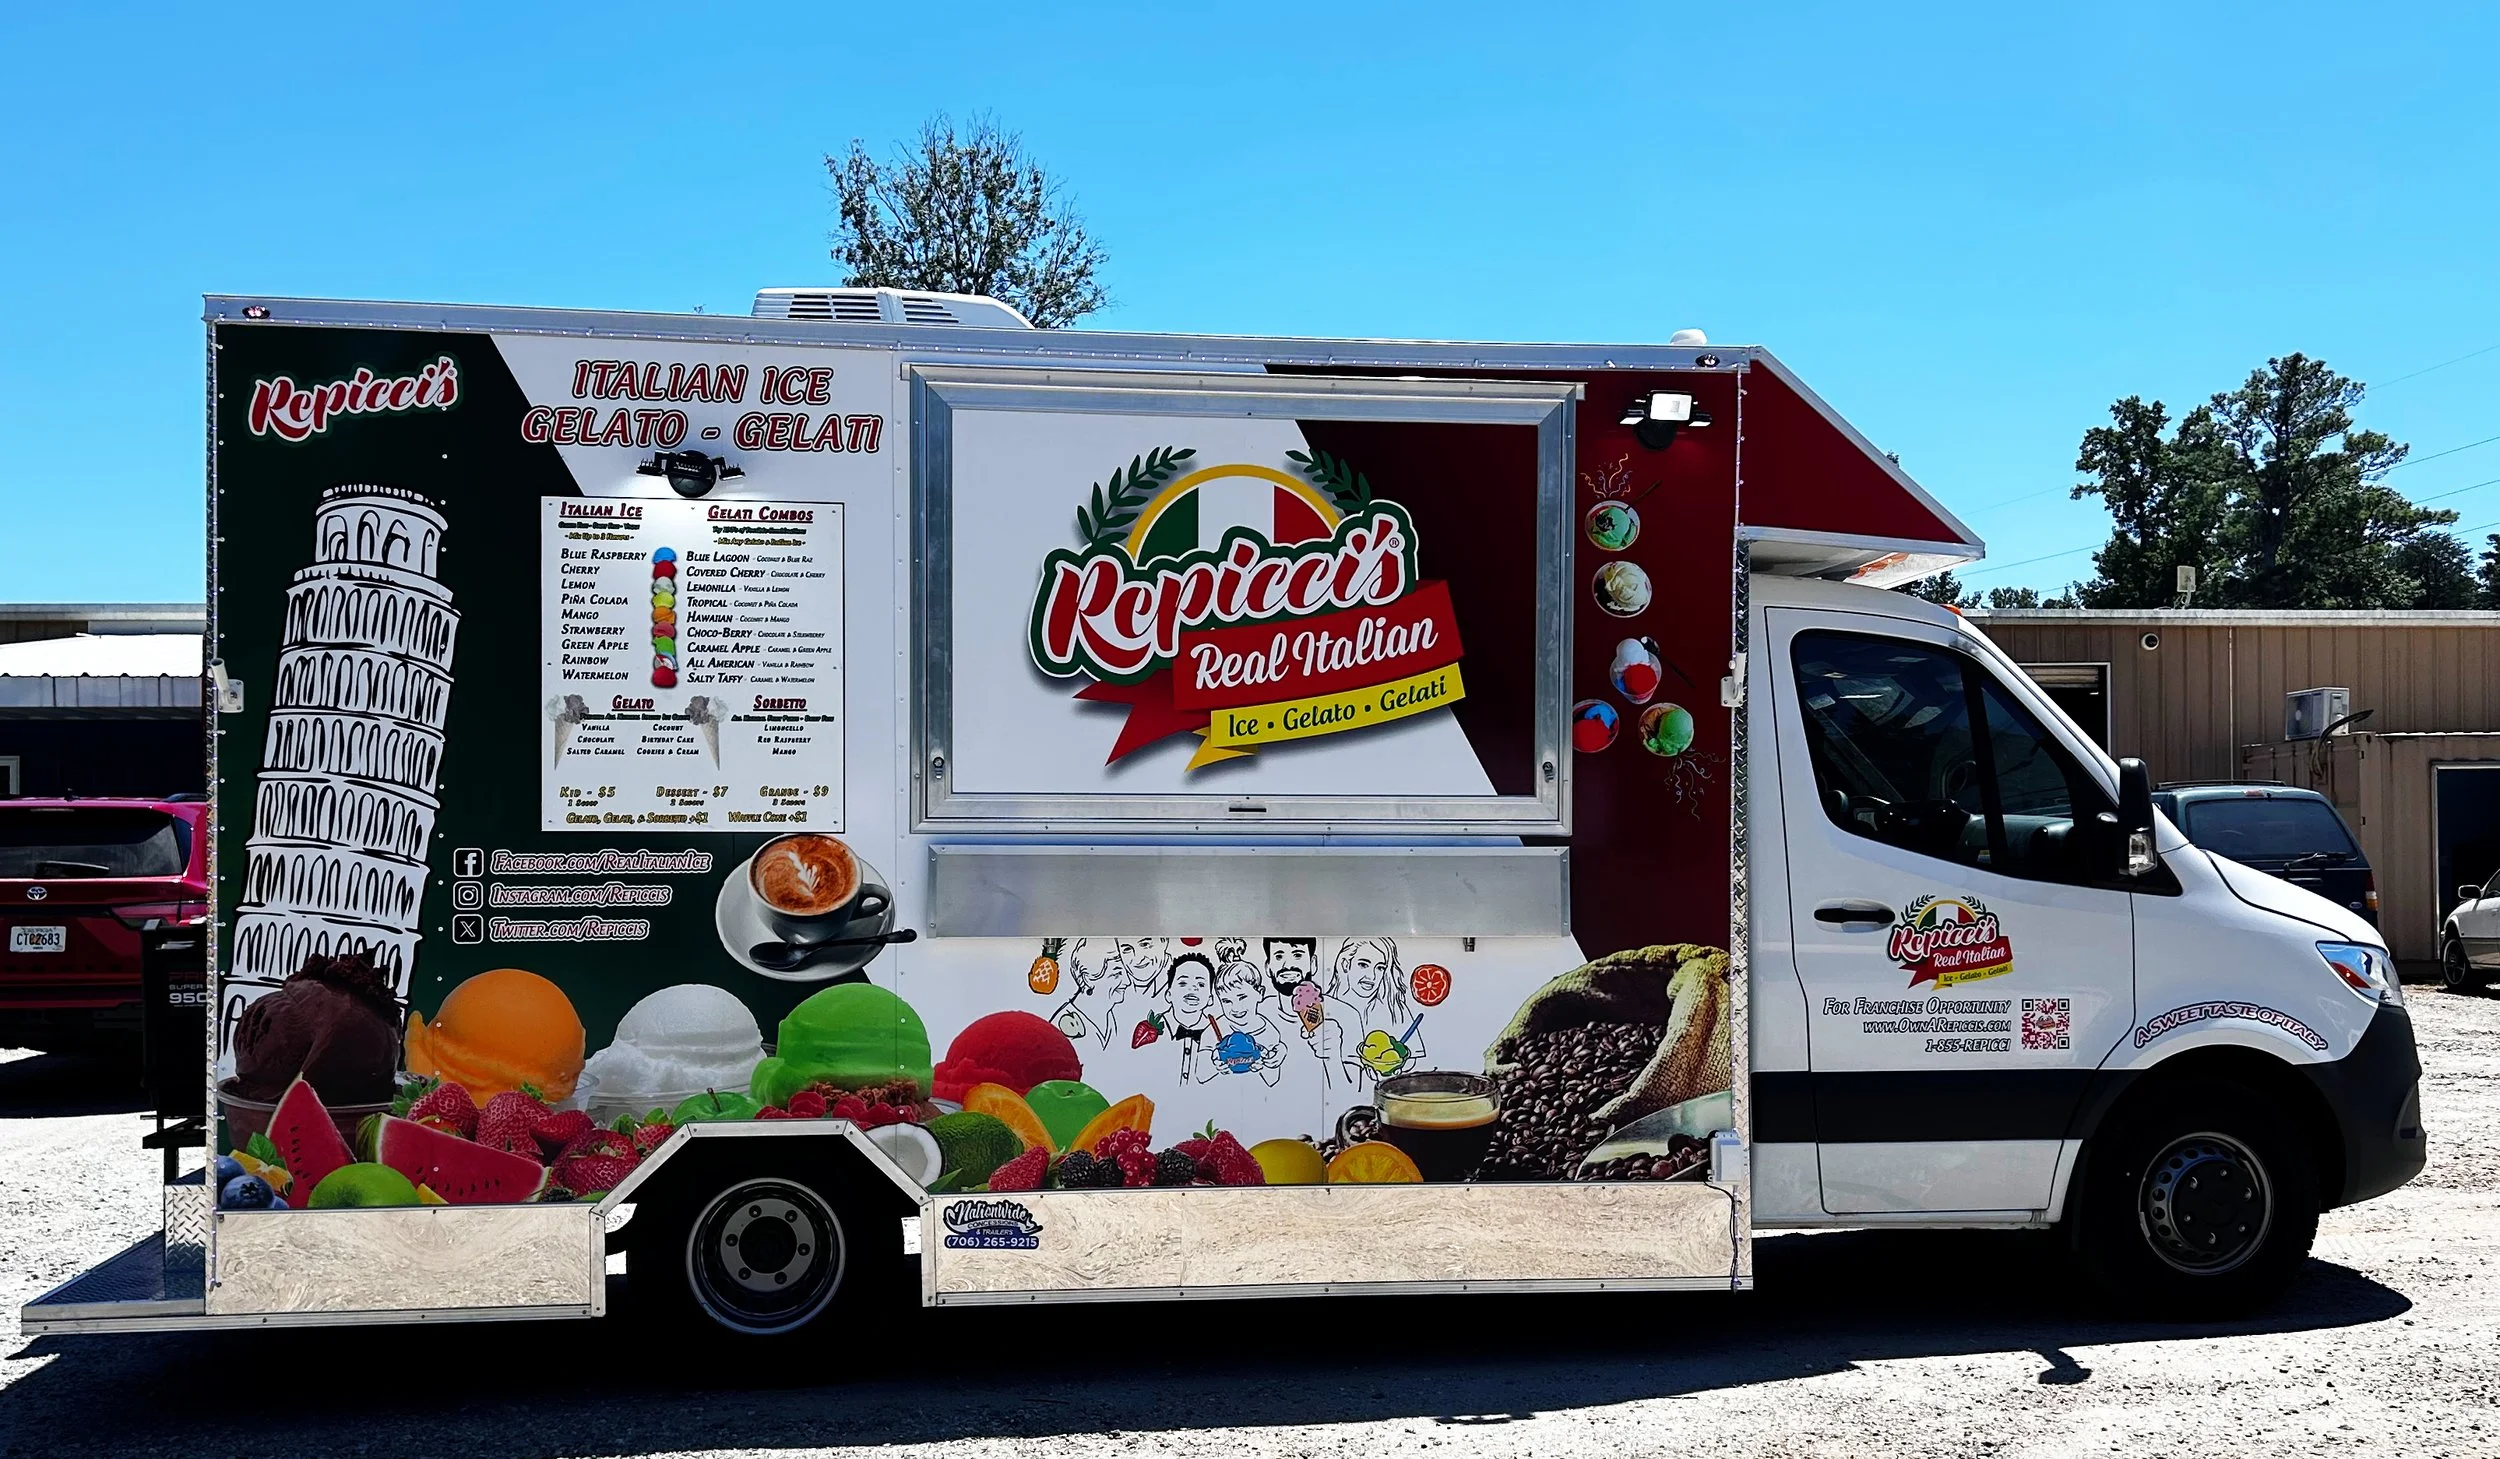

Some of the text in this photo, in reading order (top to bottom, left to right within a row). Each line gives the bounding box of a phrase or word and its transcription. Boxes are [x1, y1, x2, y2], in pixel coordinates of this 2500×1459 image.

[572, 361, 834, 404] ITALIAN ICE
[249, 356, 458, 442] Repicci's
[522, 406, 689, 448] GELATO
[734, 413, 882, 452] GELATI
[560, 502, 643, 516] ITALIAN ICE
[708, 505, 813, 521] GELATI COMBOS
[561, 548, 646, 560] BLUE RASPBERRY
[686, 551, 710, 561] BLUE
[713, 552, 749, 562] LAGOON
[561, 564, 600, 574] CHERRY
[686, 566, 727, 577] COVERED
[730, 567, 765, 577] CHERRY
[561, 579, 595, 589] LEMON
[687, 581, 736, 592] LEMONILLA
[590, 594, 628, 604] COLADA
[1040, 511, 1403, 677] Repicci's
[687, 597, 728, 607] TROPICAL
[561, 609, 599, 620] MANGO
[687, 611, 733, 622] HAWAIIAN
[561, 624, 625, 635] STRAWBERRY
[687, 627, 752, 638] CHOCO-BERRY
[562, 639, 629, 650] GREEN APPLE
[687, 642, 729, 652] CARAMEL
[731, 643, 760, 653] APPLE
[1189, 615, 1439, 691] Real Italian
[562, 654, 609, 664] RAINBOW
[687, 657, 705, 668] ALL
[707, 657, 755, 668] AMERICAN
[562, 669, 628, 680] WATERMELON
[687, 672, 715, 683] SALTY
[717, 673, 743, 683] TAFFY
[612, 695, 654, 709] GELATO
[754, 695, 806, 709] SORBETTO
[1228, 674, 1447, 737] Ice Gelato Gelati
[1890, 916, 1997, 962] Repicci's
[1933, 946, 2006, 967] Real Italian
[1823, 997, 2011, 1015] FOR FRANCHISE OPPORTUNITY
[2136, 1003, 2327, 1049] A SWEET TASTE OF ITALY
[946, 1237, 1037, 1248] (706) 265-9215
